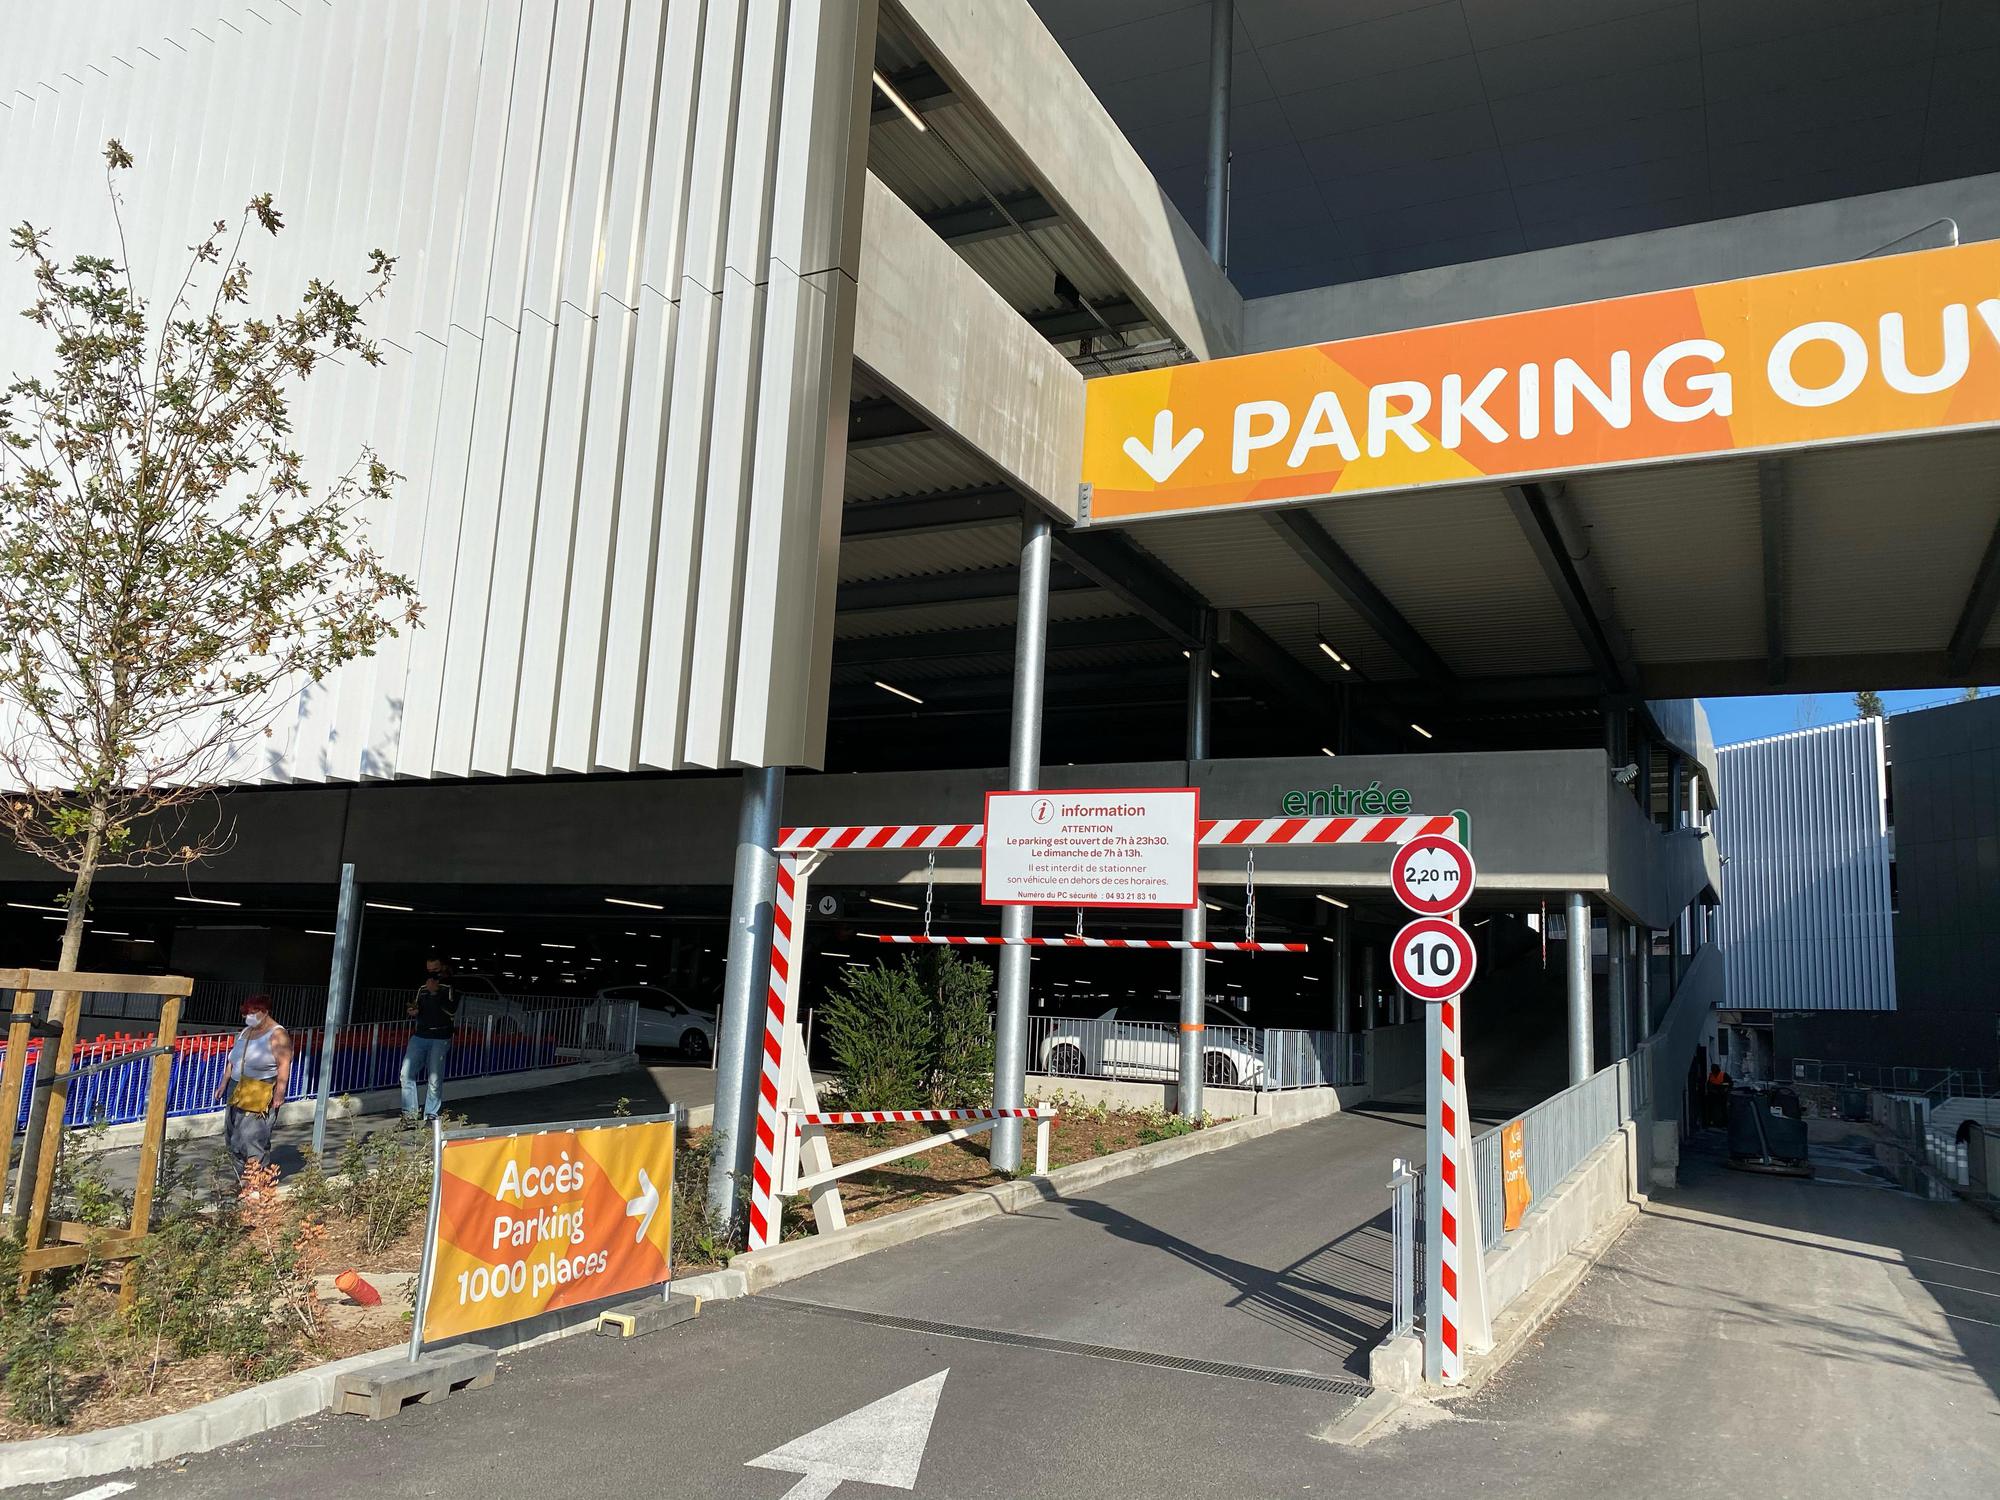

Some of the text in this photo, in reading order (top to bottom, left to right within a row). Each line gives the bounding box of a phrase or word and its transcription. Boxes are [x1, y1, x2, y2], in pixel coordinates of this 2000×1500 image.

[1231, 299, 2000, 475] PARKING OU
[1283, 781, 1412, 816] entrée
[1061, 803, 1145, 817] information
[1061, 825, 1113, 833] ATTENTION
[1007, 836, 1169, 848] Le parking est ouvert de 7h à 23h30.
[1032, 848, 1143, 858] Le dimanche de 7h à 13h.
[1029, 864, 1147, 873] Il est interdit de stationner
[1406, 867, 1459, 884] 2,20 m
[1007, 876, 1169, 886] son véhicule en dehors de ces horaires.
[1017, 891, 1045, 899] Numéro
[1046, 891, 1056, 899] du
[1057, 891, 1067, 899] PC
[1068, 891, 1098, 900] sécurité
[1410, 943, 1455, 976] 10
[496, 1151, 584, 1201] Accès
[493, 1206, 584, 1249] Parking
[458, 1250, 608, 1305] 1000 places
